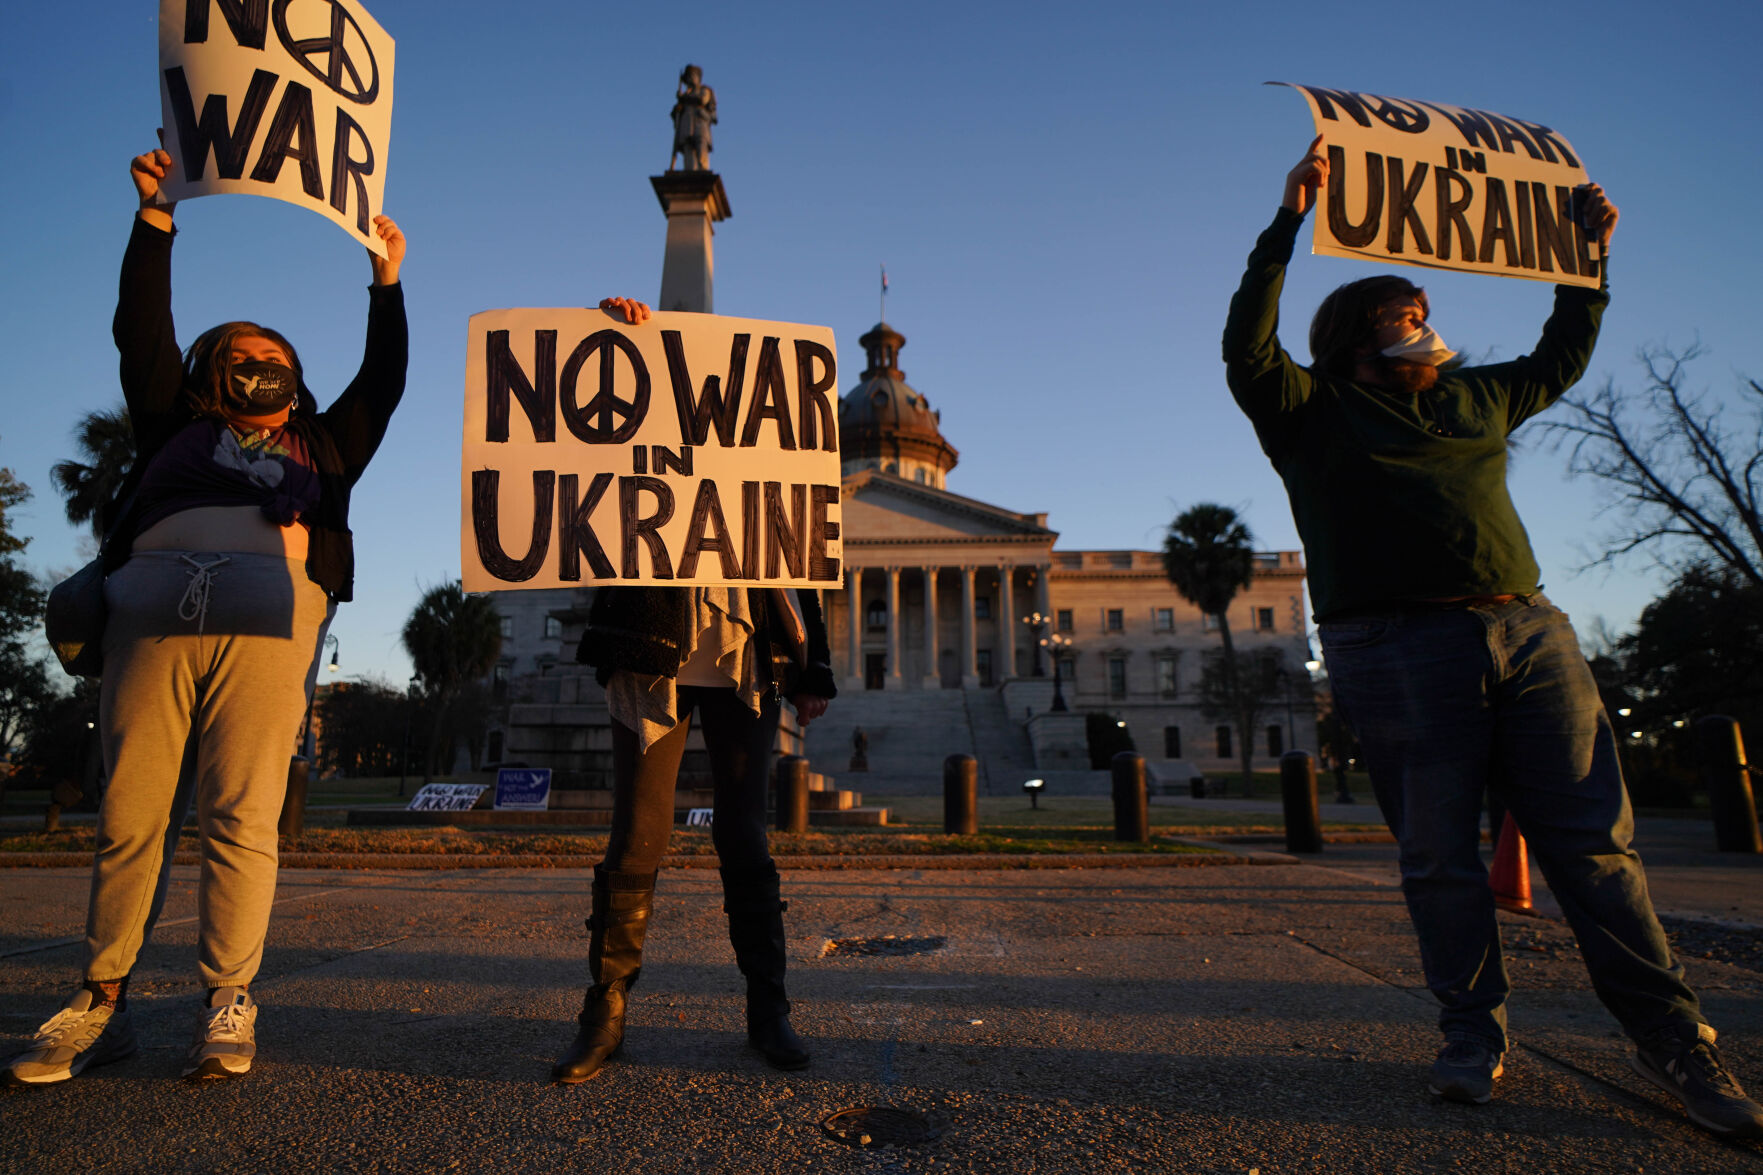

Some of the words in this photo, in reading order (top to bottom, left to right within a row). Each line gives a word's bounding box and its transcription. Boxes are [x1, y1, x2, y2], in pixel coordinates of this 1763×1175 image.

[164, 65, 375, 237] WAR
[1304, 86, 1431, 134] NO
[1412, 100, 1580, 169] WAR
[1444, 146, 1487, 173] IN
[486, 329, 651, 444] NO
[660, 330, 838, 452] WAR
[633, 445, 694, 476] IN
[472, 467, 840, 582] UKRAINE
